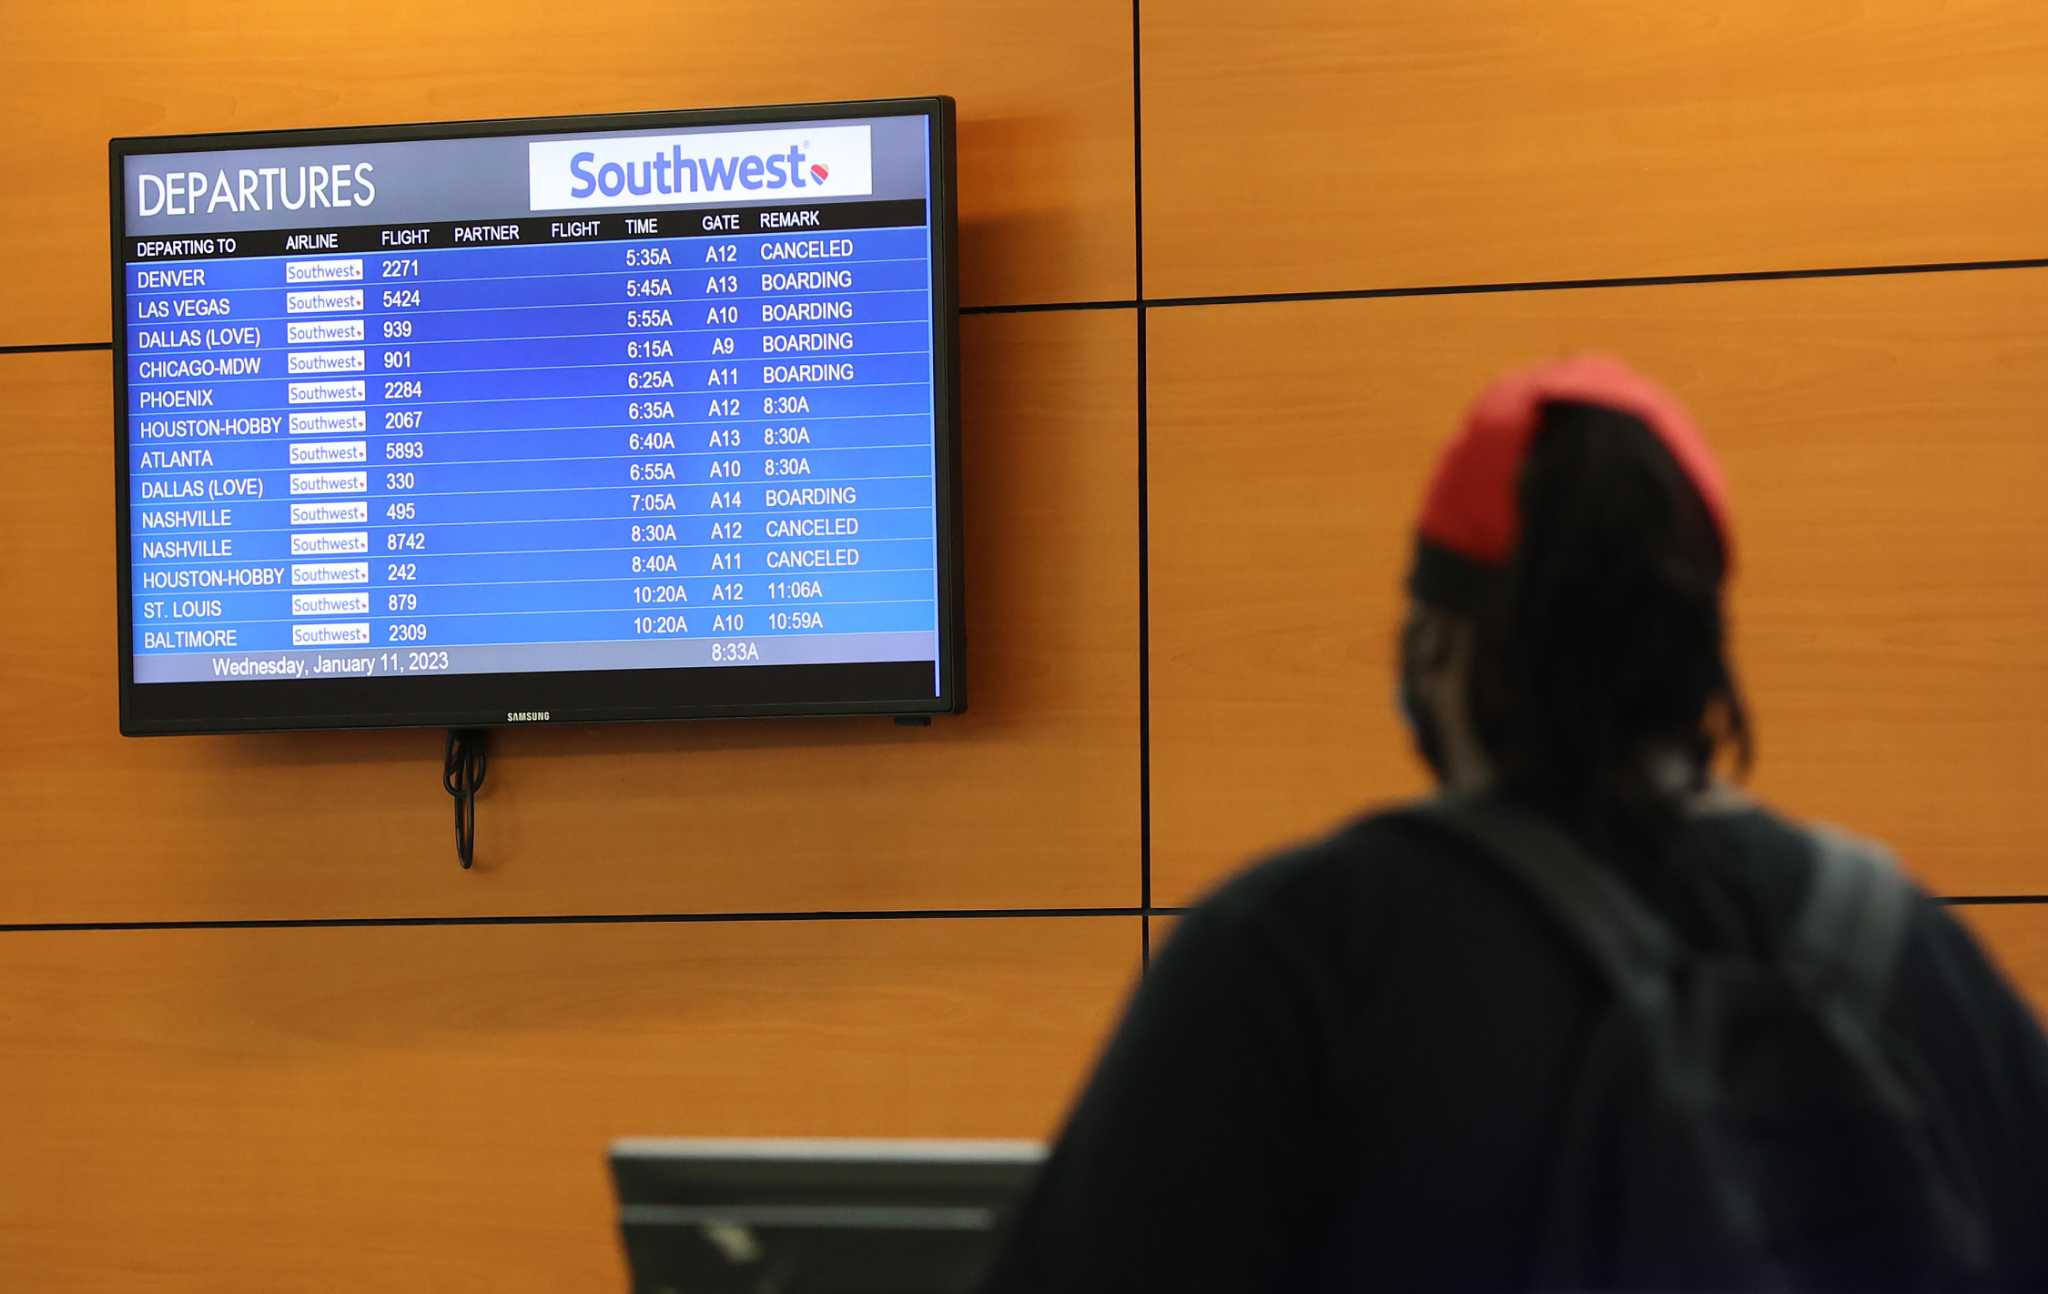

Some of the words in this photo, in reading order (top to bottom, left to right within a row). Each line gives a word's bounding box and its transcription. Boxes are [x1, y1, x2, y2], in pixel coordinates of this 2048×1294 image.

[138, 163, 376, 216] DEPARTURES
[570, 145, 806, 198] Southwest
[137, 240, 214, 257] DEPARTING
[217, 239, 236, 253] TO
[286, 234, 338, 250] AIRLINE
[381, 229, 430, 246] FLIGHT
[454, 225, 520, 242] PARTNER
[552, 221, 600, 237] FLIGHT
[626, 218, 658, 234] TIME
[702, 214, 740, 231] GATE
[760, 211, 819, 227] REMARK
[138, 270, 205, 288] DENVER
[288, 264, 355, 280] Southwest
[382, 260, 419, 277] 2271
[626, 248, 671, 265] 5:35A
[705, 245, 737, 262] A12
[760, 240, 854, 260] CANCELED
[138, 301, 169, 319] LAS
[173, 299, 230, 317] VEGAS
[289, 294, 356, 310] Southwest
[383, 290, 420, 308] 5424
[626, 279, 672, 297] 5:45A
[706, 276, 737, 294] A13
[761, 270, 852, 291] BOARDING
[138, 330, 201, 349] DALLAS
[206, 327, 260, 349] (LOVE)
[289, 325, 356, 340] Southwest
[383, 321, 412, 338] 939
[627, 310, 673, 328] 5:55A
[707, 307, 738, 325] A10
[762, 301, 853, 322] BOARDING
[139, 358, 261, 379] CHICAGO-MDW
[290, 355, 357, 371] Southwest
[384, 351, 411, 369] 901
[627, 340, 673, 358] 6:15A
[712, 338, 734, 355] A9
[763, 333, 853, 353] BOARDING
[140, 389, 213, 408] PHOENIX
[290, 385, 357, 401] Southwest
[384, 381, 422, 399] 2284
[628, 371, 674, 389] 6:25A
[708, 369, 738, 386] A11
[763, 363, 854, 384] BOARDING
[141, 417, 281, 439] HOUSTON-HOBBY
[291, 415, 358, 431] Southwest
[385, 412, 422, 429] 2067
[629, 402, 674, 420] 6:35A
[708, 400, 740, 417] A12
[764, 397, 809, 415] 8:30A
[141, 450, 213, 469] ATLANTA
[291, 446, 358, 461] Southwest
[385, 442, 423, 460] 5893
[629, 433, 675, 451] 6:40A
[709, 430, 740, 447] A13
[764, 428, 810, 445] 8:30A
[141, 480, 204, 498] DALLAS
[209, 478, 264, 501] (LOVE)
[292, 476, 359, 492] Southwest
[386, 473, 414, 490] 330
[630, 463, 676, 481] 6:55A
[710, 461, 741, 478] A10
[764, 459, 810, 476] 8:30A
[142, 509, 231, 529] NASHVILLE
[292, 507, 359, 522] Southwest
[387, 503, 415, 520] 495
[631, 494, 676, 512] 7:05A
[710, 492, 741, 509] A14
[765, 487, 856, 507] BOARDING
[143, 539, 232, 558] NASHVILLE
[293, 537, 360, 552] Southwest
[387, 533, 425, 551] 8742
[631, 525, 676, 542] 8:30A
[711, 523, 742, 540] A12
[766, 518, 859, 538] CANCELED
[143, 567, 284, 589] HOUSTON-HOBBY
[293, 567, 360, 582] Southwest
[388, 564, 416, 581] 242
[632, 555, 677, 573] 8:40A
[712, 553, 741, 571] A11
[767, 549, 859, 569] CANCELED
[143, 601, 168, 619] ST.
[173, 599, 221, 617] LOUIS
[294, 597, 361, 613] Southwest
[389, 594, 417, 611] 879
[633, 585, 687, 604] 10:20A
[712, 584, 743, 601] A12
[768, 580, 822, 599] 11:06A
[145, 629, 237, 649] BALTIMORE
[294, 627, 361, 643] Southwest
[389, 624, 426, 642] 2309
[634, 616, 688, 634] 10:20A
[713, 615, 743, 632] A10
[769, 611, 823, 630] 10:59A
[213, 657, 308, 679] Wednesday,
[313, 655, 375, 675] January
[380, 654, 404, 674] 11,
[409, 652, 449, 671] 2023
[712, 643, 759, 662] 8:33A
[507, 711, 550, 722] SAMSUNG
